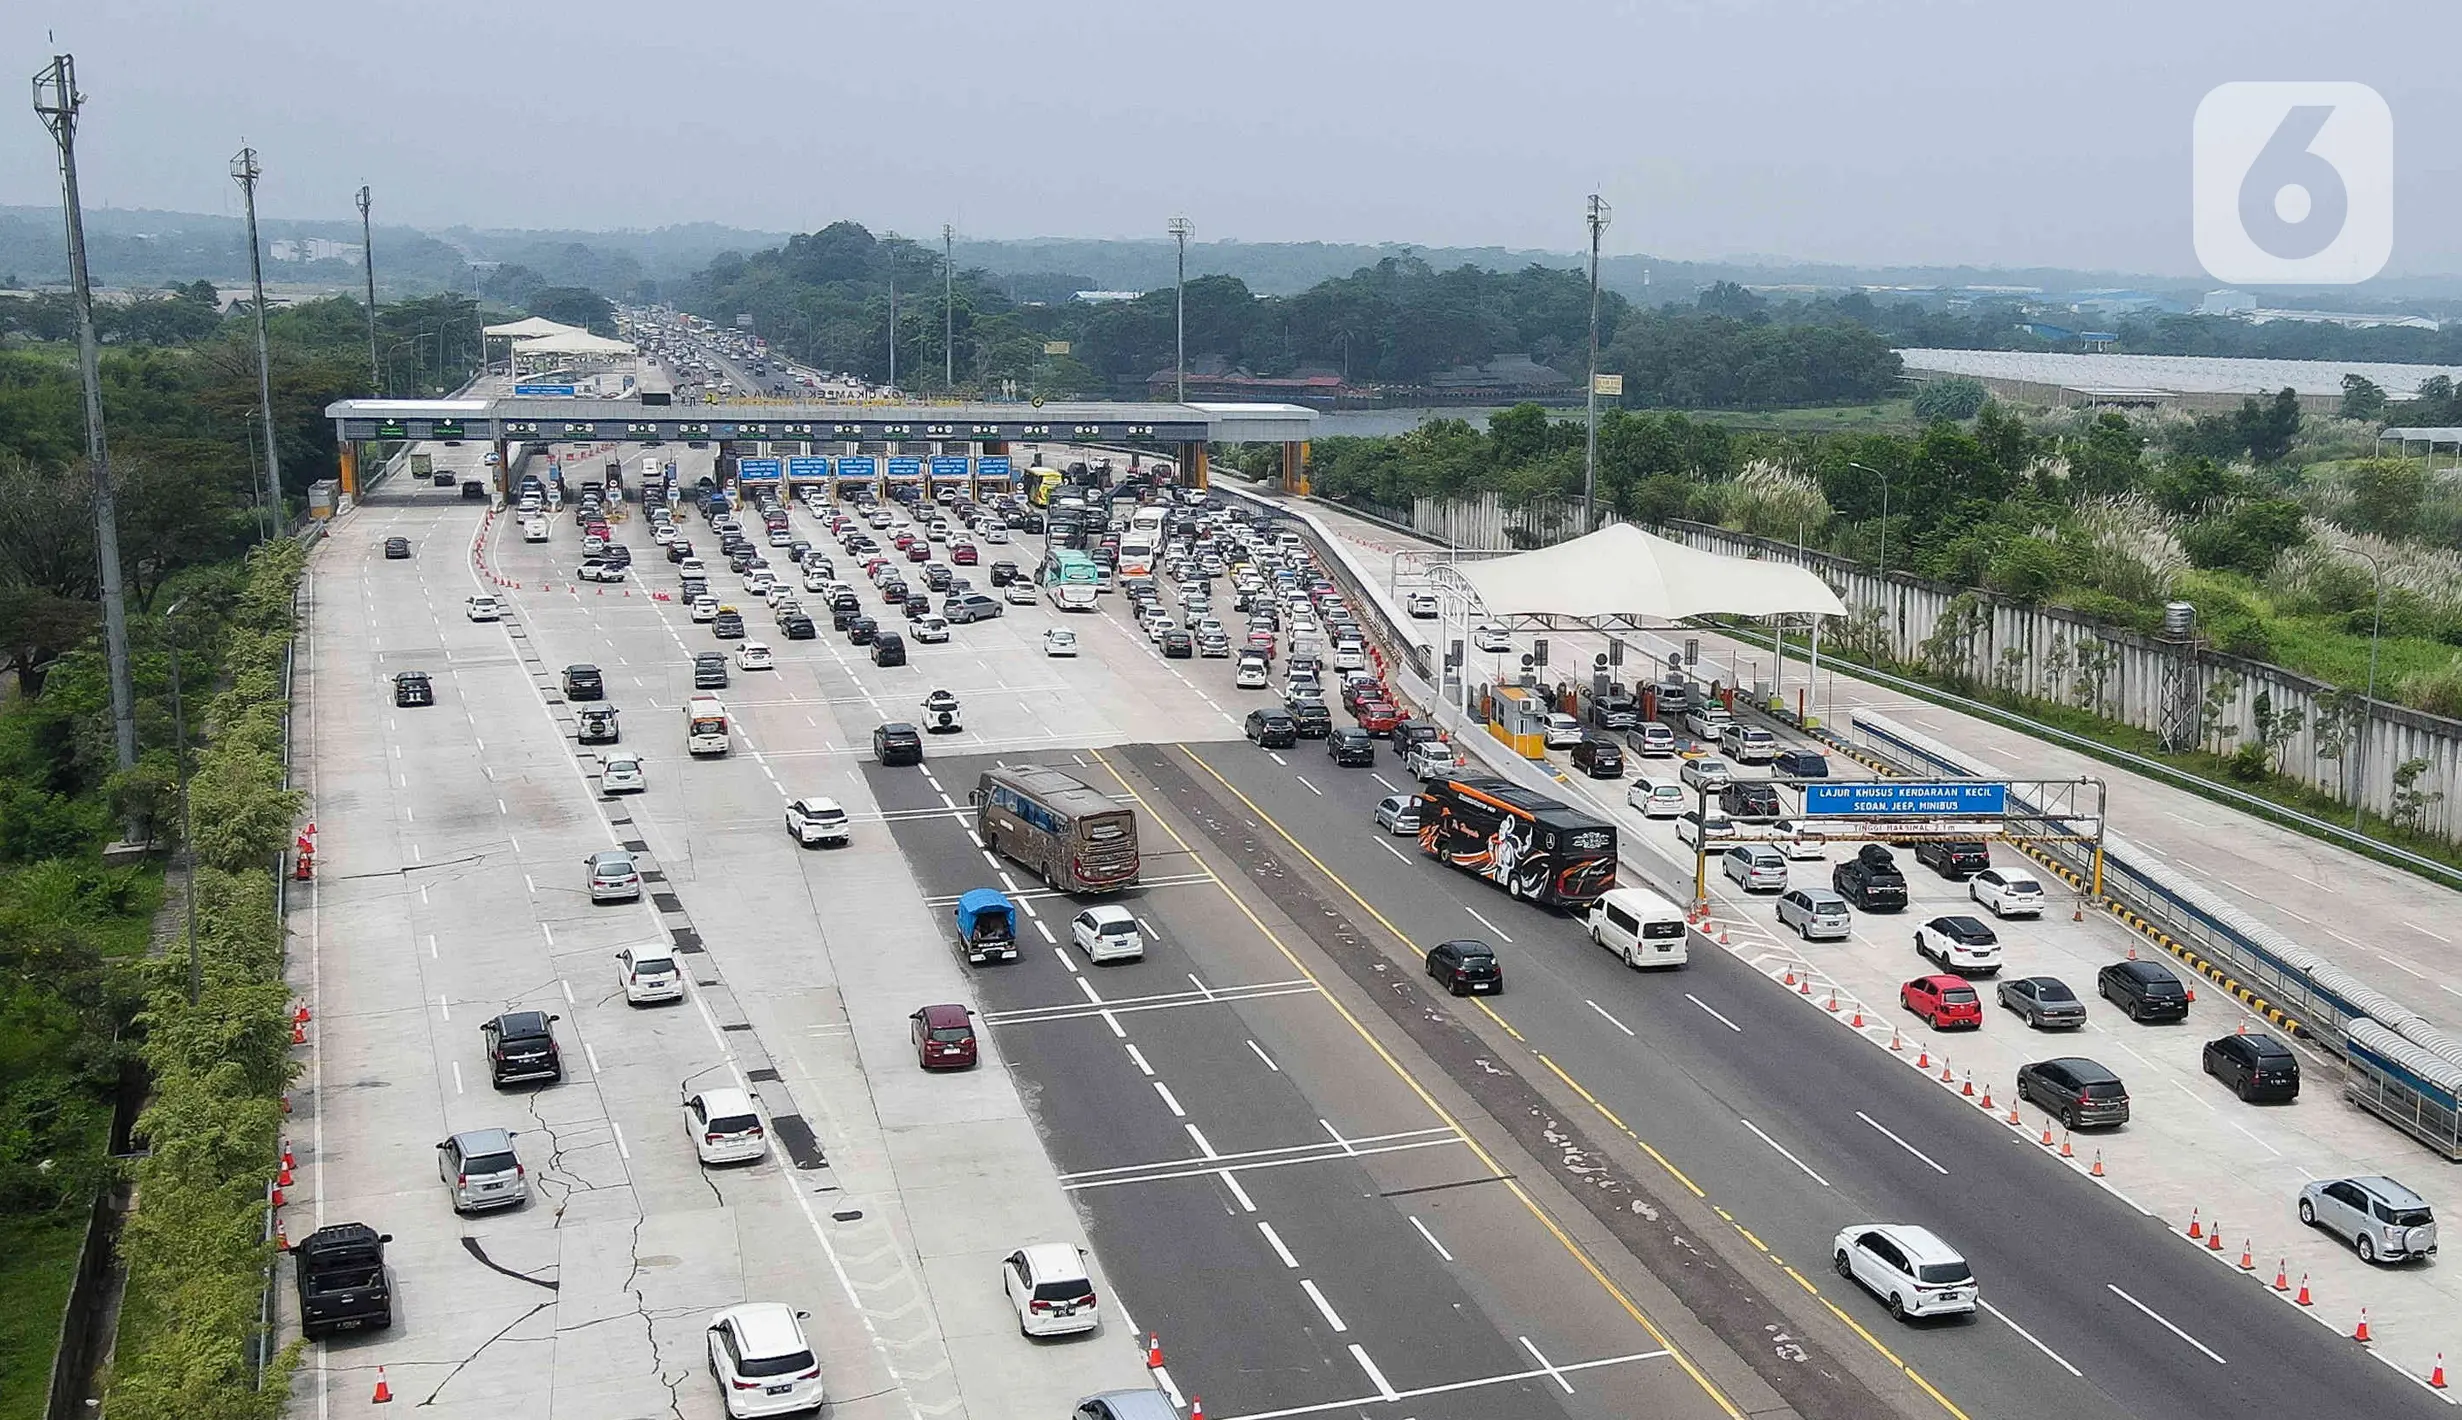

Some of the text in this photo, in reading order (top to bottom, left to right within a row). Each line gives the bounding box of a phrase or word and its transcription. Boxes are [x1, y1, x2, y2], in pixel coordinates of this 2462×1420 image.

[1819, 788, 1992, 797] LAJUR KHUSUS KENDARAAN KECIL
[1891, 802, 1915, 811] JEEP,
[1919, 802, 1958, 810] MINIBUS
[1886, 824, 1928, 832] MAKSIMAL
